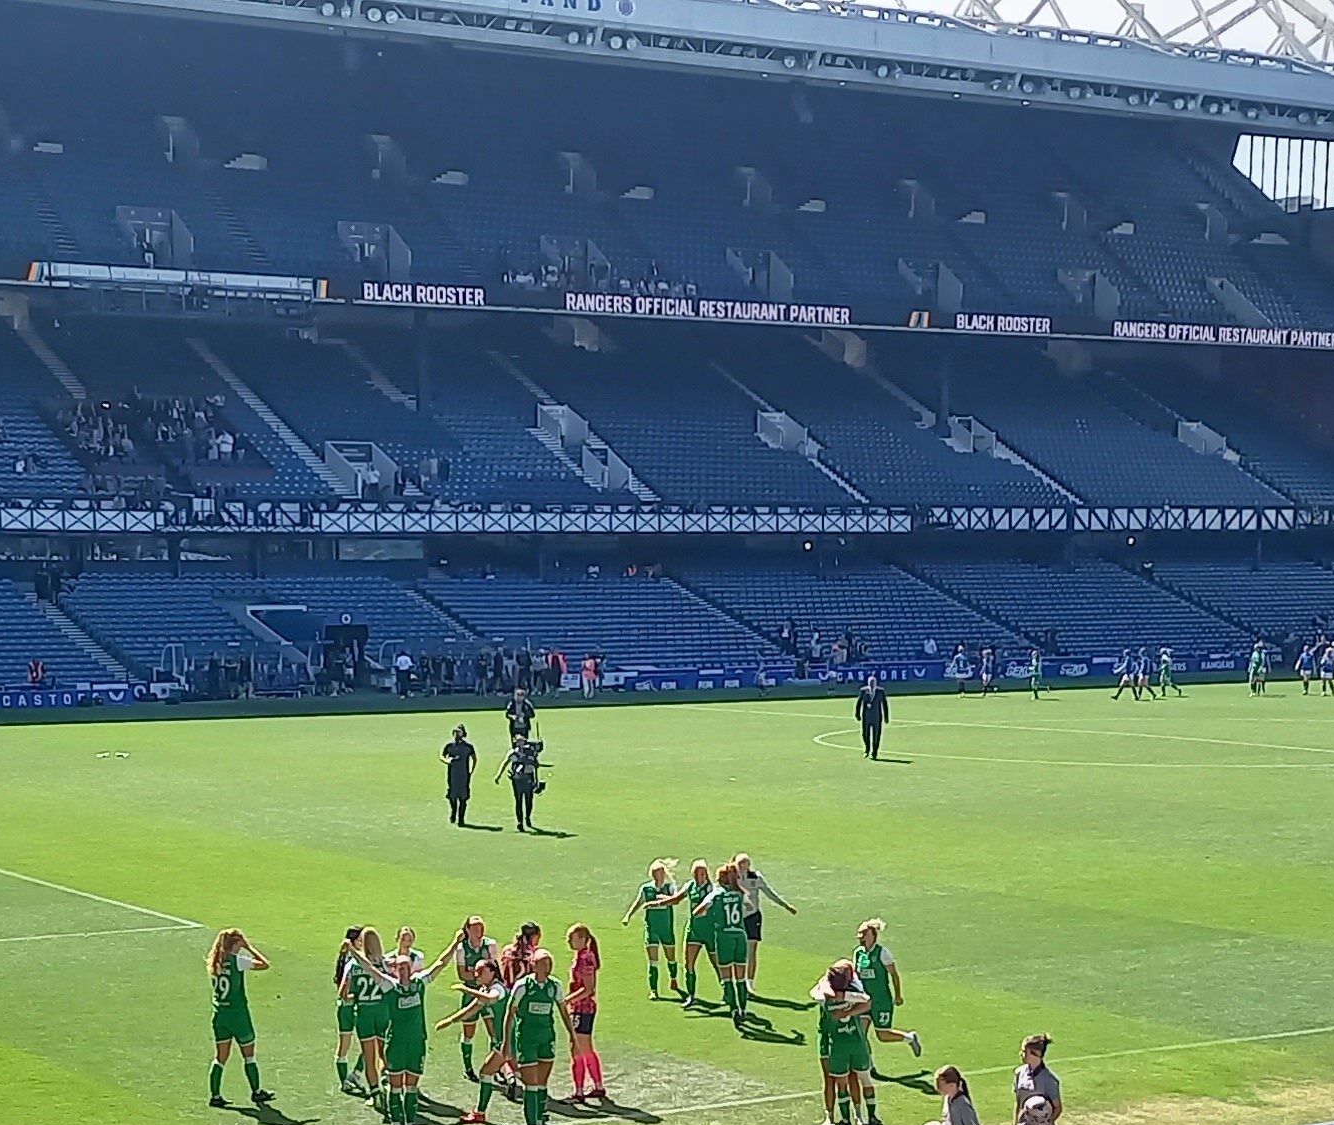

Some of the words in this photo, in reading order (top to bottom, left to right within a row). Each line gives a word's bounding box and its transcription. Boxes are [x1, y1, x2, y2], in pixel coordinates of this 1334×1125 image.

[363, 282, 411, 304] BLACK
[416, 284, 485, 306] ROOSTER
[566, 292, 632, 315] RANGERS
[636, 295, 695, 318] OFFICIAL
[699, 299, 786, 322] RESTAURANT
[789, 304, 850, 325] PARTNER
[956, 312, 995, 331] BLACK
[999, 314, 1051, 335] ROOSTER
[1113, 320, 1165, 340] RANGERS
[1168, 322, 1216, 343] OFFICIAL
[1218, 325, 1287, 347] RESTAURANT
[724, 903, 740, 925] 16
[357, 976, 383, 1001] 22
